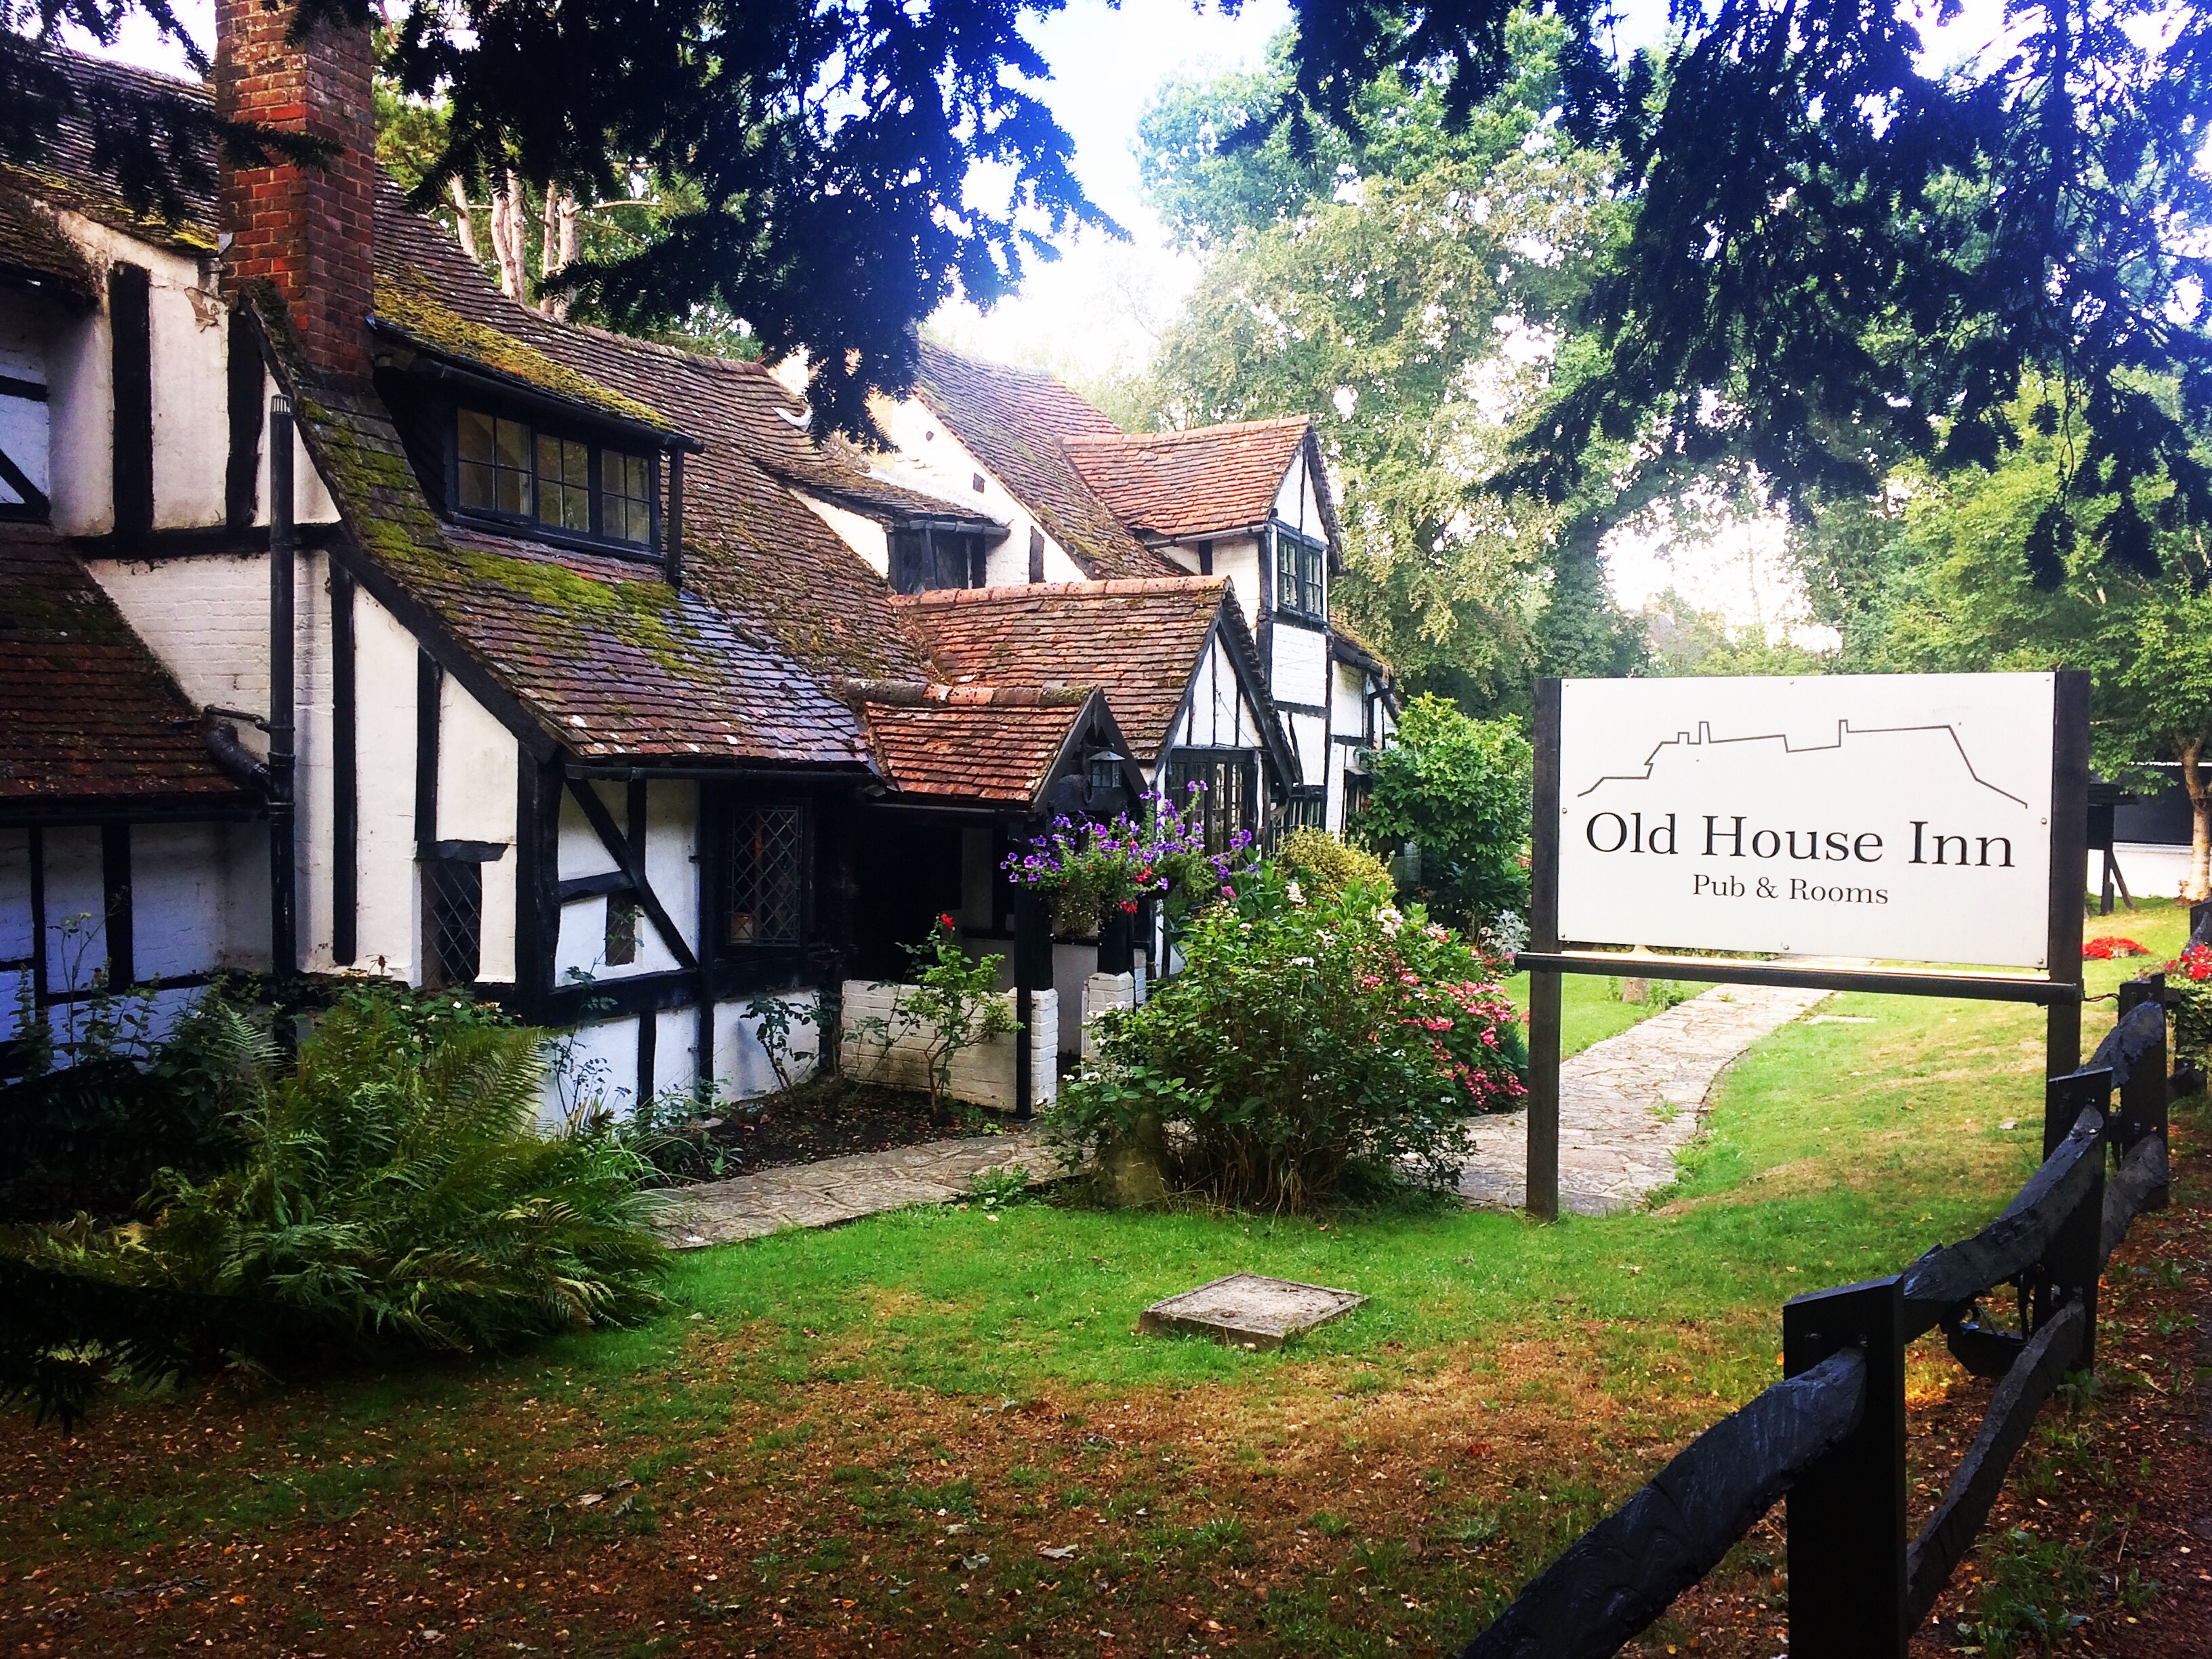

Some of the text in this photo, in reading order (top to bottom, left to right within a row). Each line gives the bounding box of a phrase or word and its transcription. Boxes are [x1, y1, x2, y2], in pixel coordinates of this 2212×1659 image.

[1586, 812, 2015, 867] Old House Inn
[1693, 874, 1889, 905] Pub & Rooms
